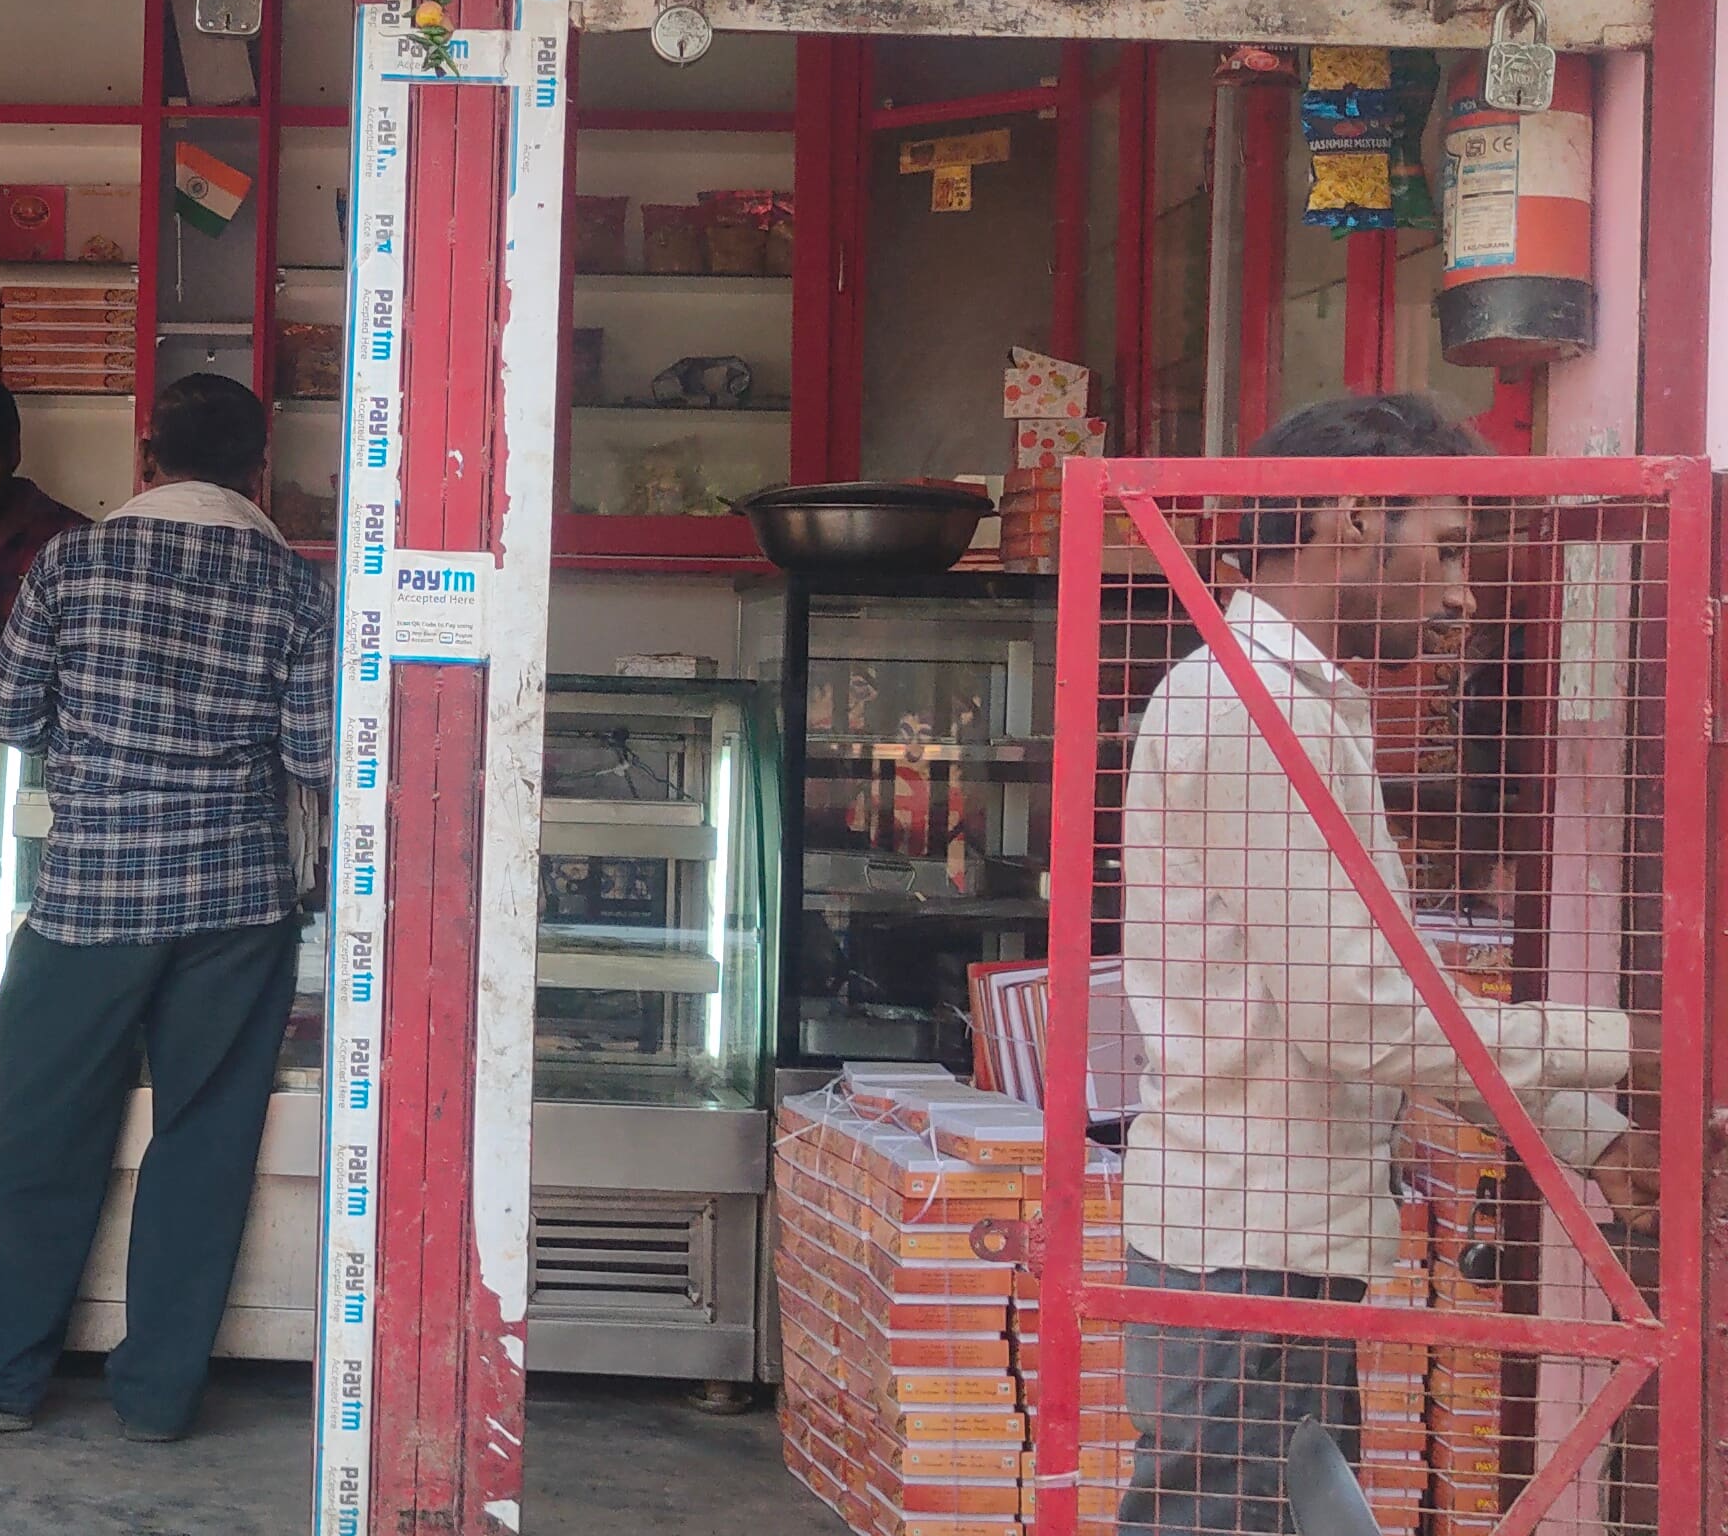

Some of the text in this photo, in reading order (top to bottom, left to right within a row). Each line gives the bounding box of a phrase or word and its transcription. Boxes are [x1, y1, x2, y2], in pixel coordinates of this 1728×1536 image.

[398, 38, 469, 59] pam
[372, 290, 394, 360] paytm
[368, 397, 390, 468] paytm
[364, 504, 386, 575] paytm
[397, 567, 476, 593] paytm
[397, 592, 476, 605] Accepted Here
[360, 611, 383, 682] paytm
[357, 718, 379, 789] paytm
[353, 825, 376, 896] paytm
[351, 931, 374, 1002] paytm
[350, 1039, 372, 1109] paytm
[347, 1146, 369, 1216] paytm
[344, 1253, 366, 1324] paytm
[341, 1360, 363, 1431] paytm
